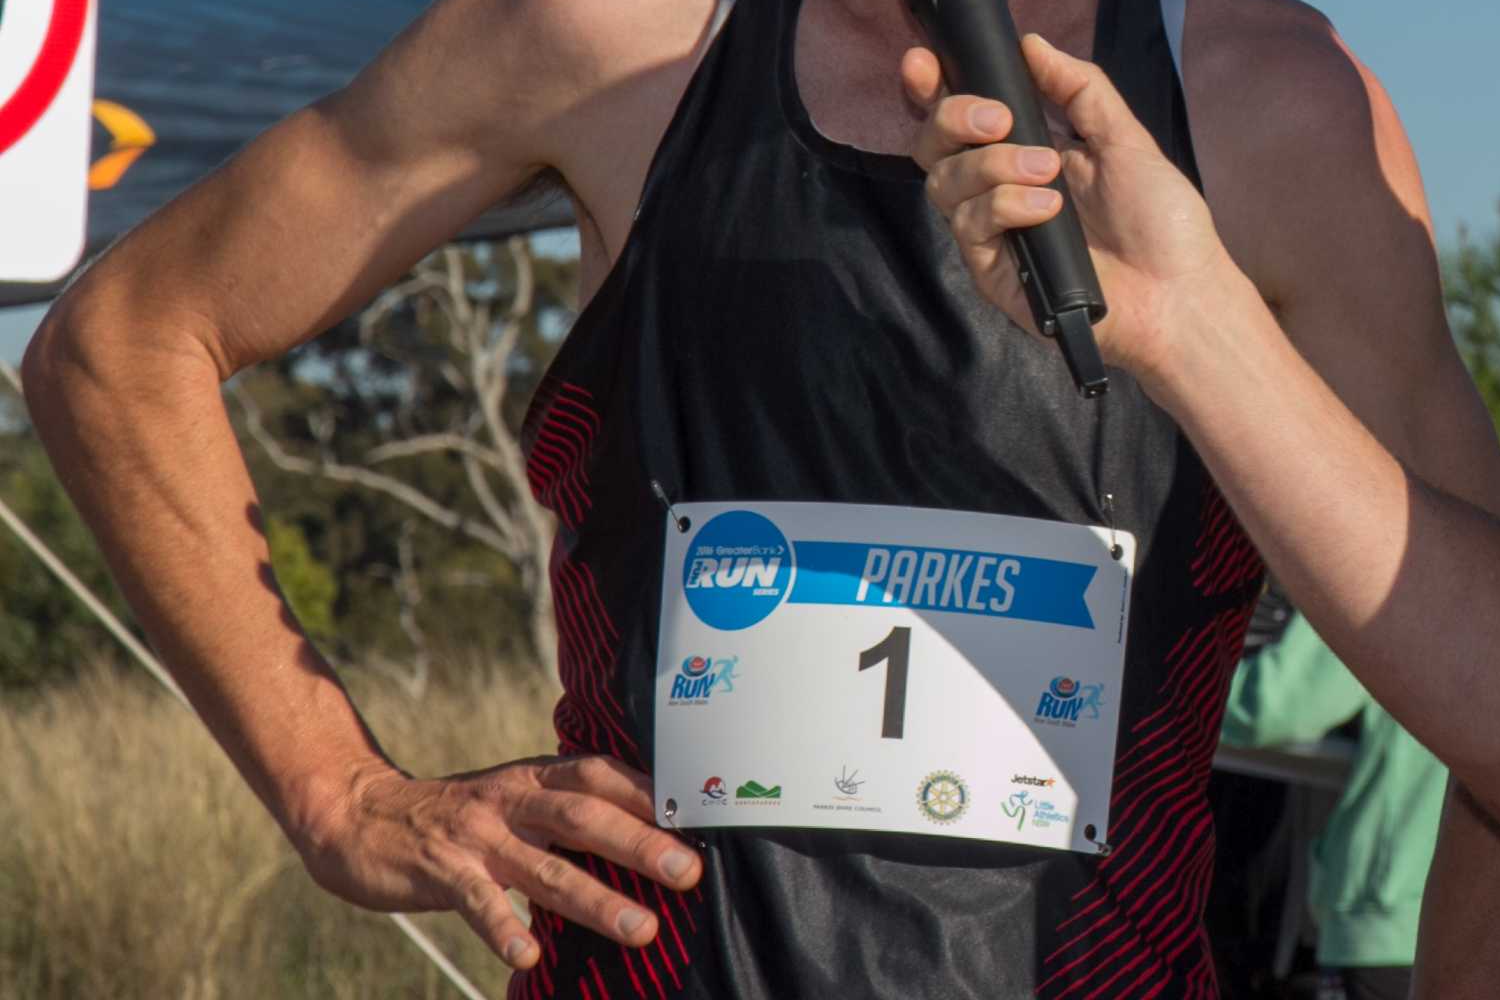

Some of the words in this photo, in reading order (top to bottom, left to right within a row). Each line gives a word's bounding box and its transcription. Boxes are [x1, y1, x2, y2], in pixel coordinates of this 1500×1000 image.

[687, 556, 782, 589] RUN
[856, 547, 1021, 613] PARKES
[671, 673, 716, 699] RUN
[857, 625, 912, 740] 1
[1036, 691, 1084, 721] RUN
[1011, 774, 1047, 787] Jetstar
